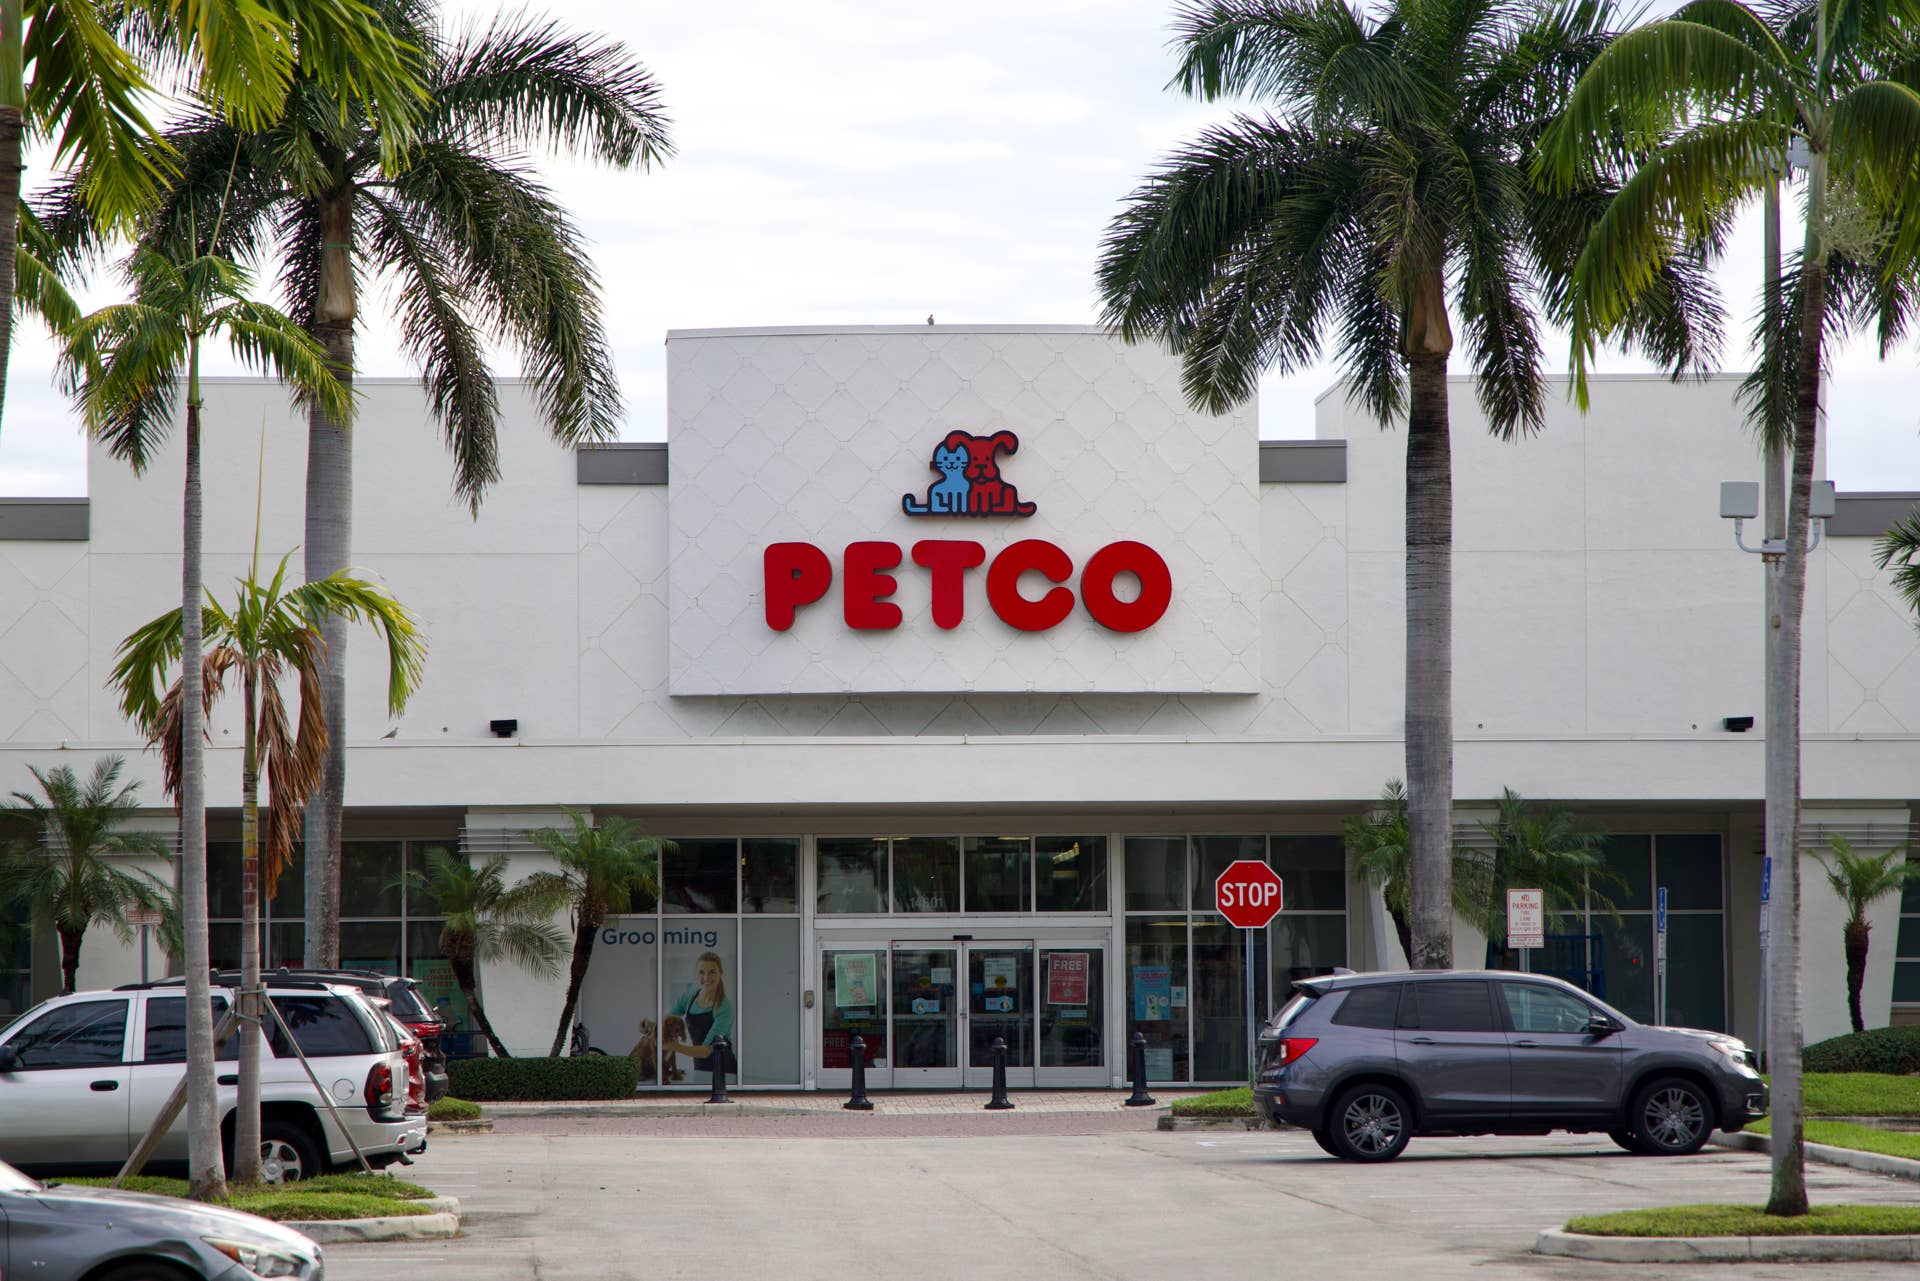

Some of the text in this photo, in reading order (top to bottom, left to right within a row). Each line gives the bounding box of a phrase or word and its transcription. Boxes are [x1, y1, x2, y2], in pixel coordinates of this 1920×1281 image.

[764, 539, 1172, 632] PETCO
[1221, 882, 1278, 907] STOP
[1512, 902, 1539, 910] PARKING
[602, 927, 718, 947] Grooming
[1053, 960, 1083, 971] FREE
